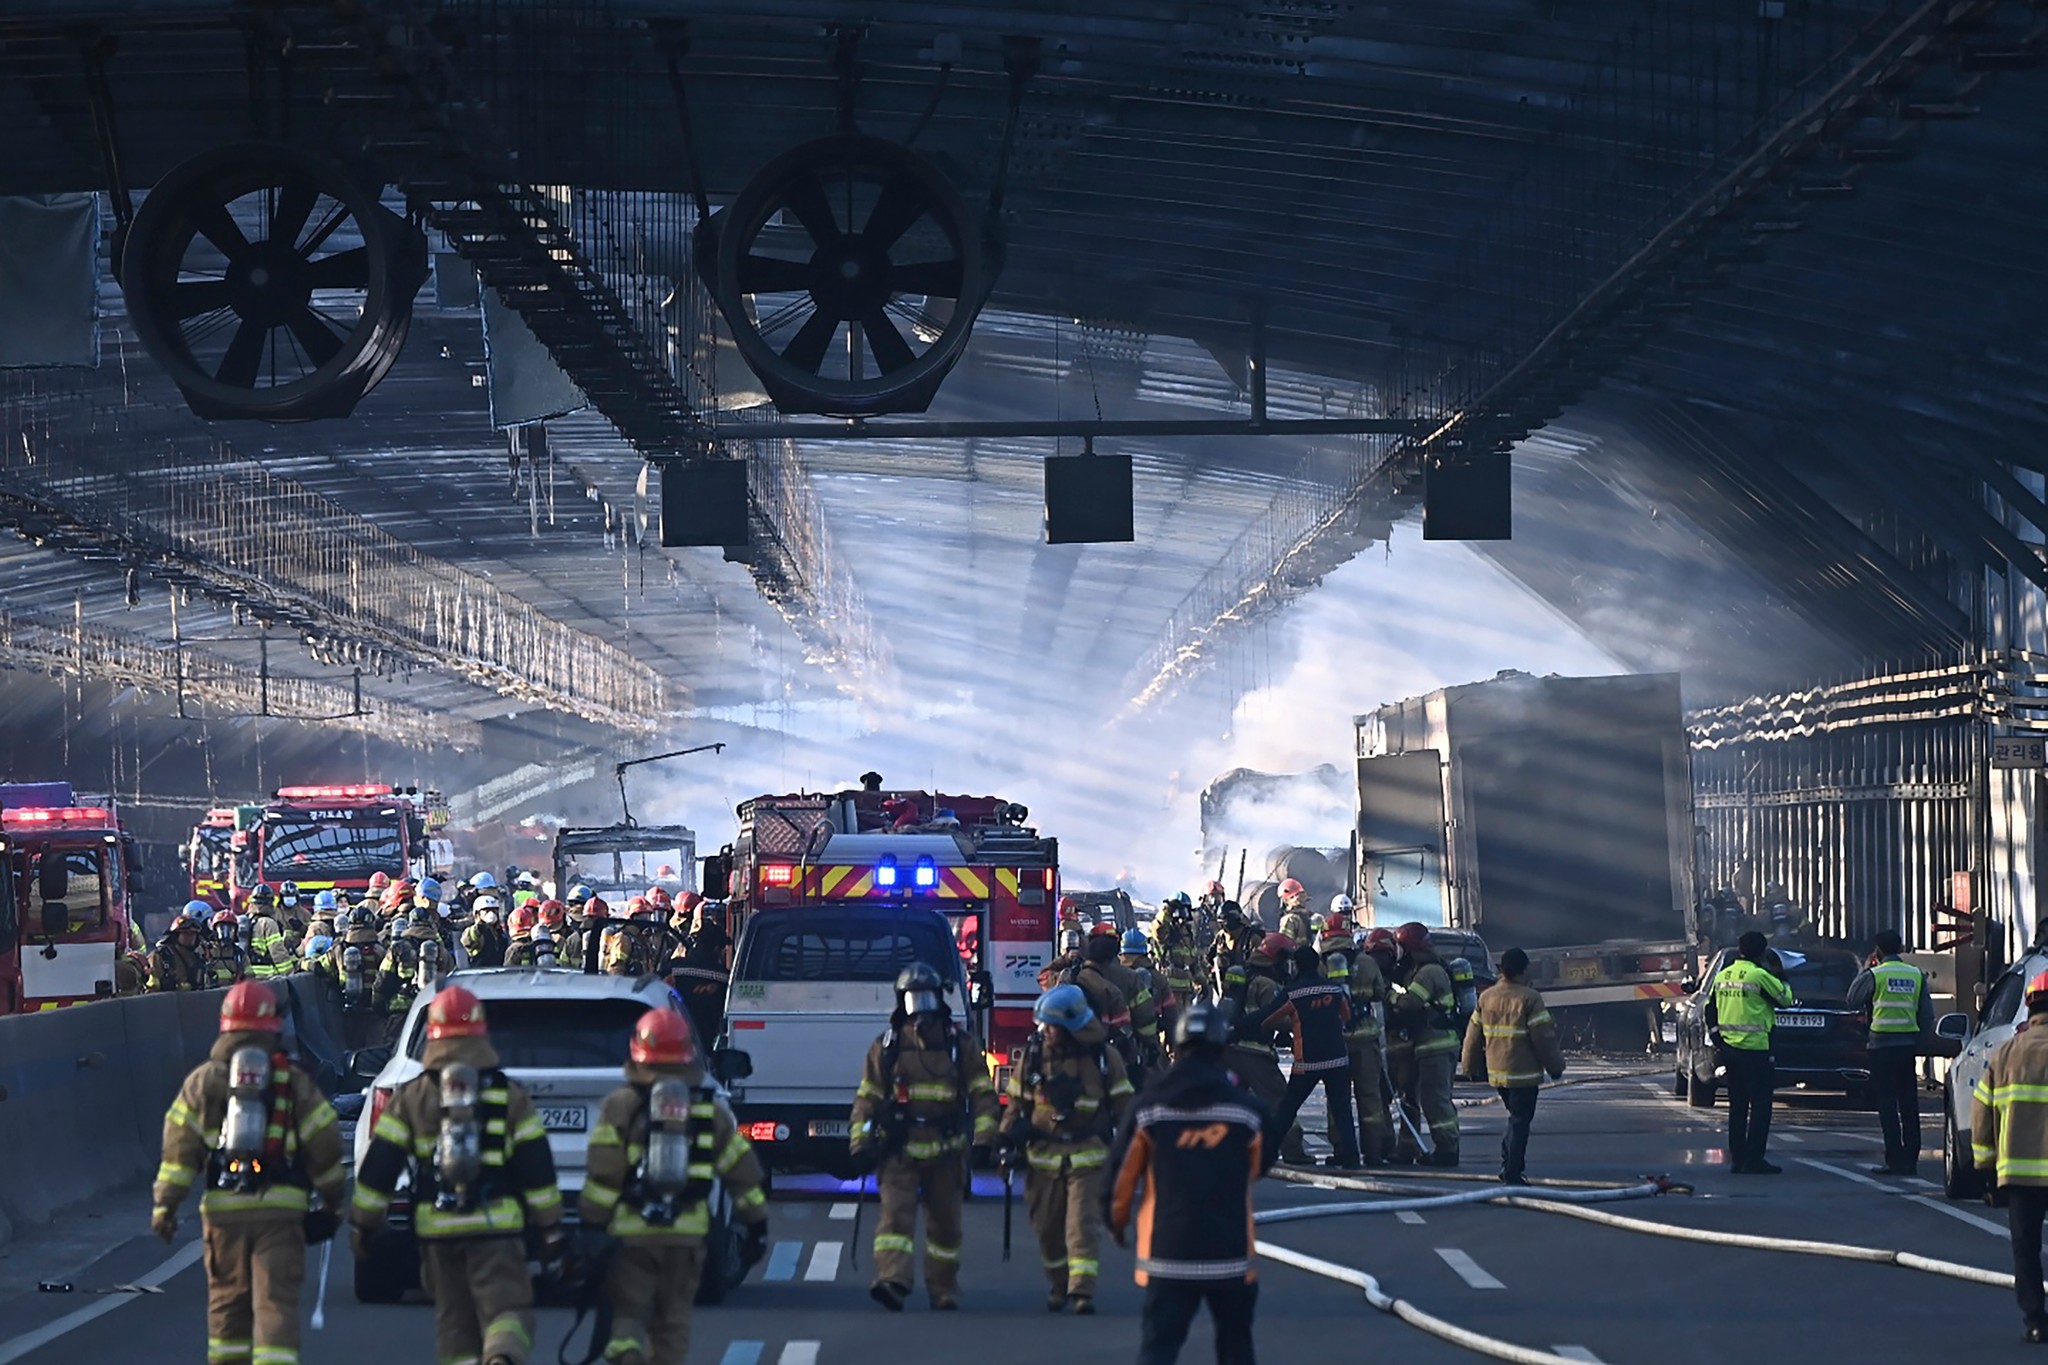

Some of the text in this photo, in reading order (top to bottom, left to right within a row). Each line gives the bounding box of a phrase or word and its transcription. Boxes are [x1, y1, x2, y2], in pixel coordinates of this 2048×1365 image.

[1996, 744, 2042, 761] 관리용
[309, 809, 353, 820] 경기도소방
[543, 1110, 581, 1126] 2942
[1176, 1122, 1228, 1149] 119
